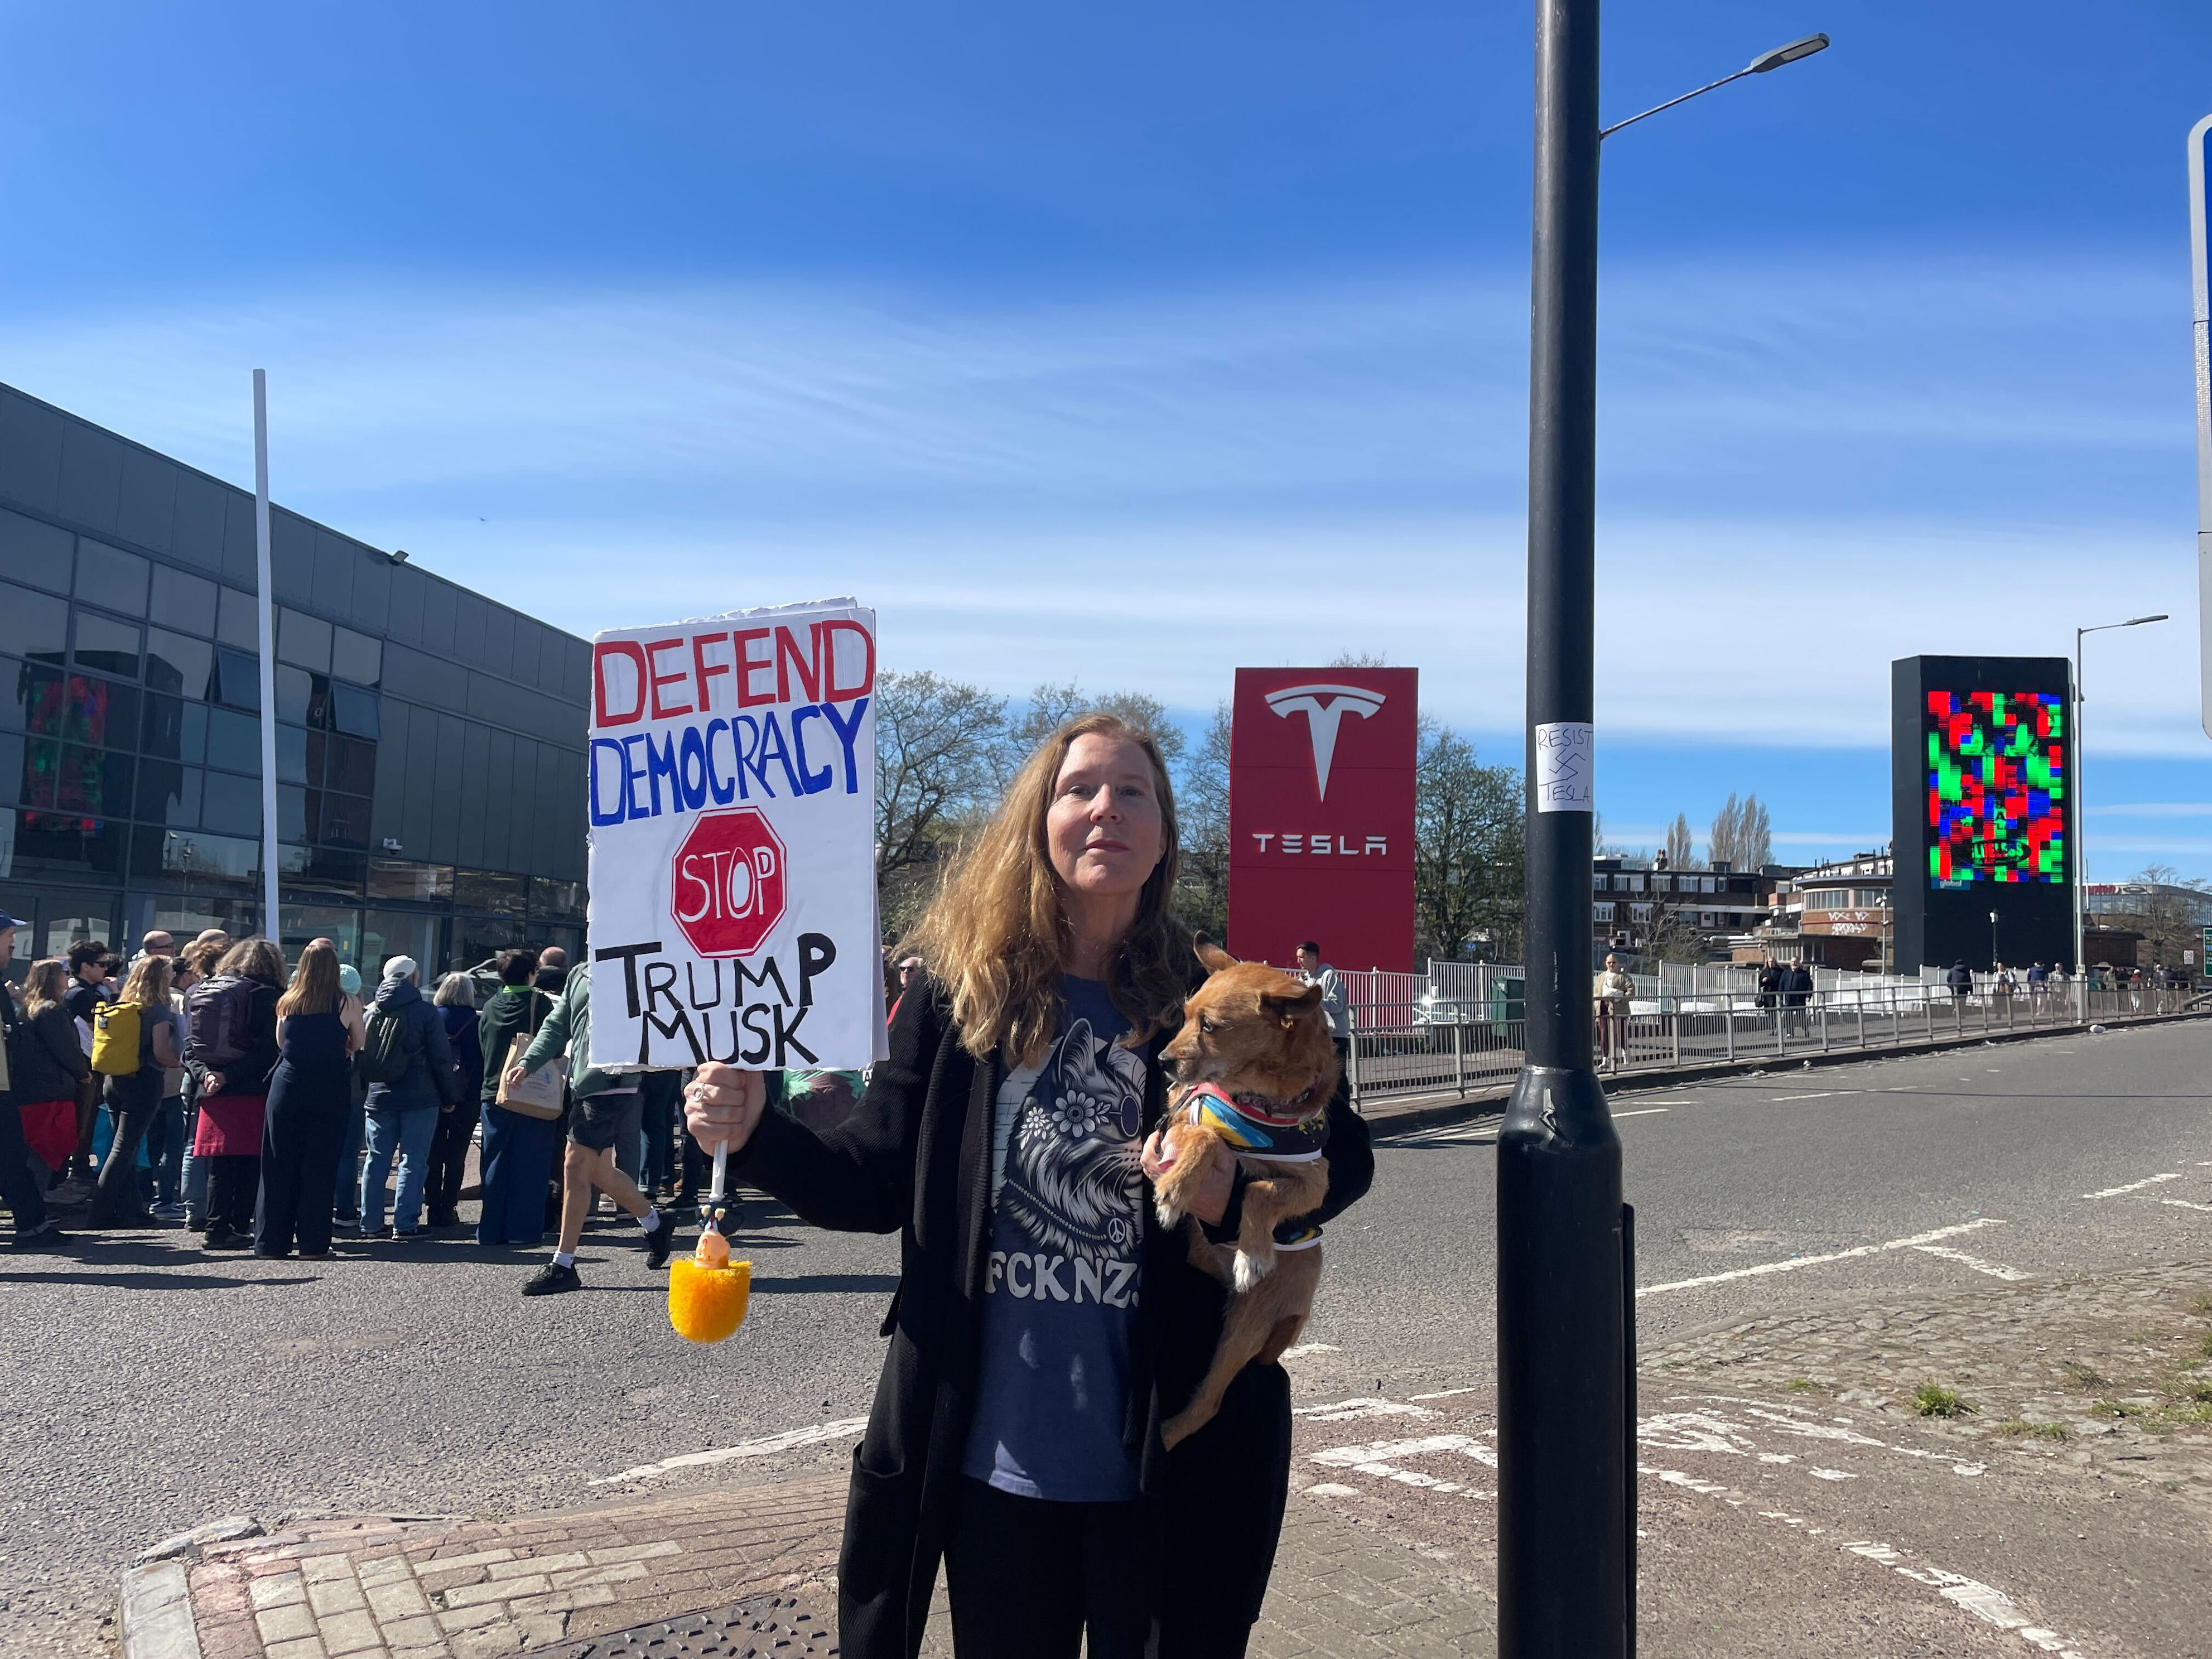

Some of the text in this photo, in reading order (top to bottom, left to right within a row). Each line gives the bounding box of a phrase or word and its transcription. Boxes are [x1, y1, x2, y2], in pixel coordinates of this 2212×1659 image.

[594, 620, 875, 728] DEFEND
[590, 698, 869, 826] DEMOCRACY
[1538, 729, 1593, 750] RESIST
[1539, 782, 1591, 803] TESLA
[1252, 833, 1387, 855] TESLA
[679, 846, 775, 922] STOP
[1939, 879, 1962, 889] global
[595, 933, 836, 1018] TRUMP
[638, 1002, 820, 1065] MUSK
[985, 1251, 1070, 1301] FCK
